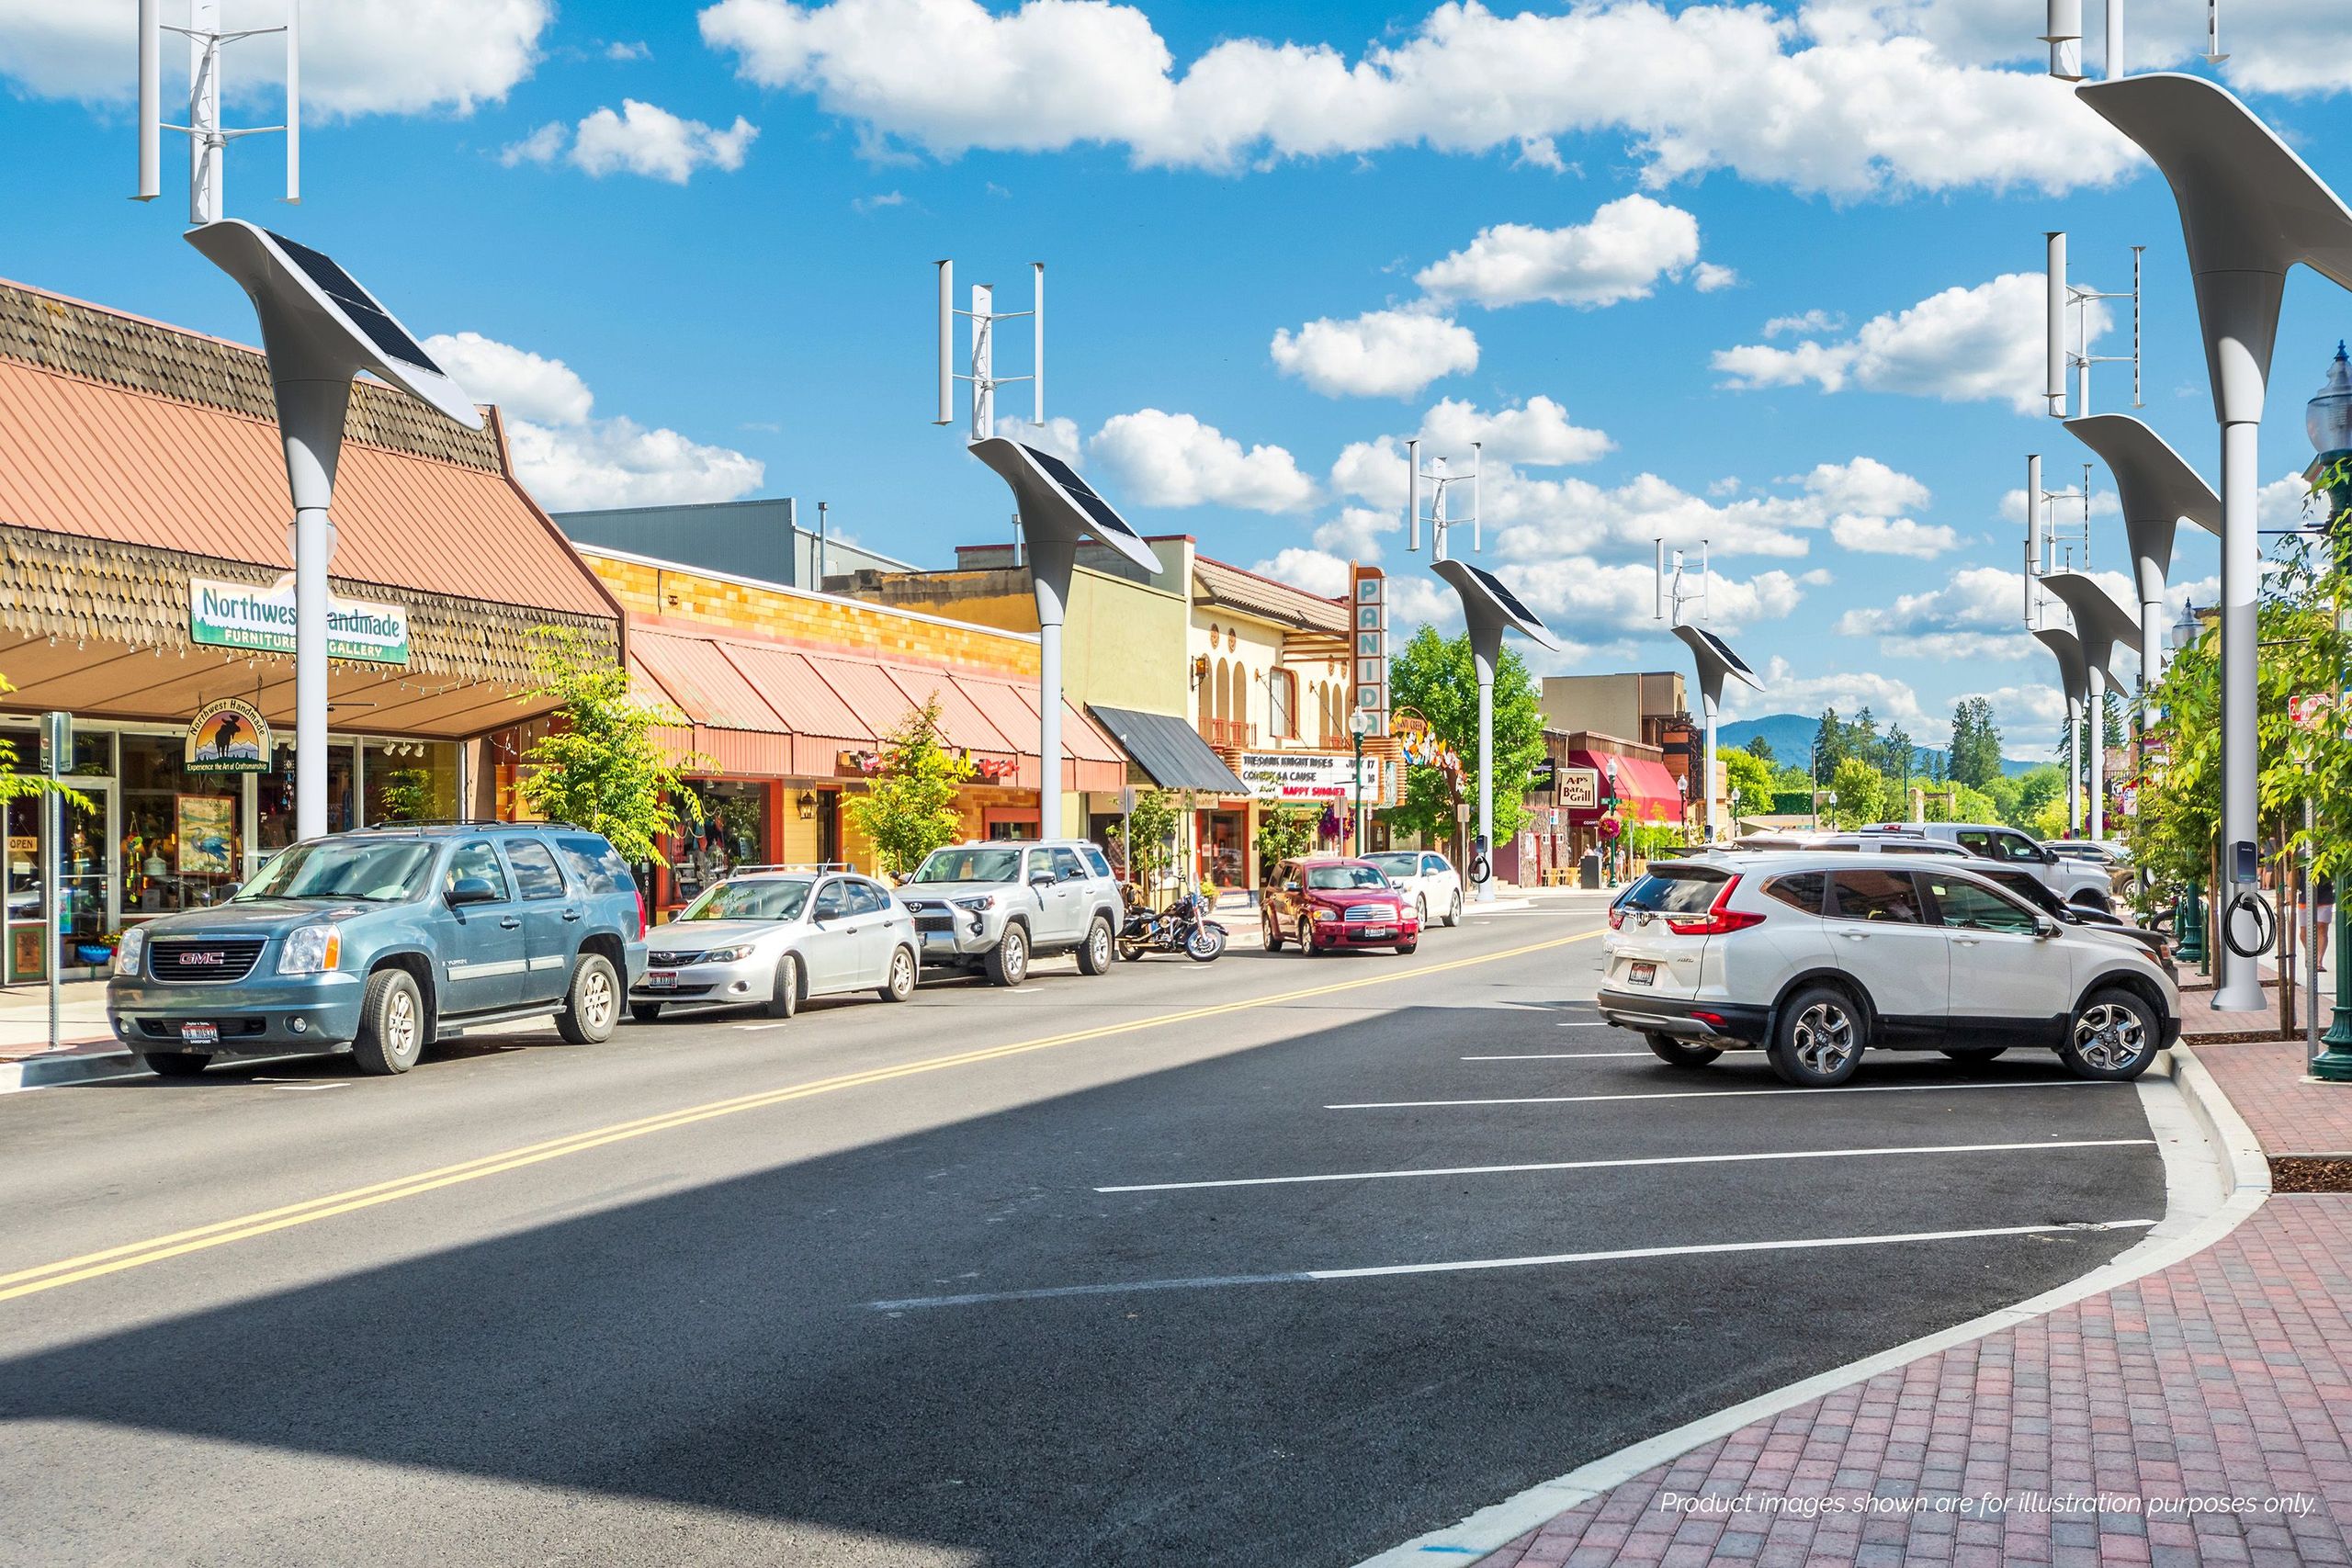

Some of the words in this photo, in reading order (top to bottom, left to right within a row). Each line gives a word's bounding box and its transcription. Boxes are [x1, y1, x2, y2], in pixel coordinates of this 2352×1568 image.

[202, 587, 296, 626] Northwes
[327, 609, 400, 637] andmade
[224, 629, 296, 649] FURNITURE
[328, 641, 382, 657] GALLERY
[1361, 581, 1377, 734] PANIDA
[190, 701, 227, 736] Northwest
[230, 699, 266, 737] Handmade
[187, 763, 213, 772] Experience
[235, 762, 267, 771] Craftsmanship
[1281, 757, 1308, 767] KNIGHT
[1309, 758, 1333, 768] RISES
[1345, 759, 1364, 768] JUY
[1367, 760, 1375, 769] 17
[1289, 773, 1317, 781] CAUSE
[1283, 786, 1309, 795] HAPPY
[1312, 787, 1345, 796] SUMMER
[1570, 790, 1590, 802] Grill
[10, 840, 33, 849] OPEN
[179, 952, 225, 964] GMC
